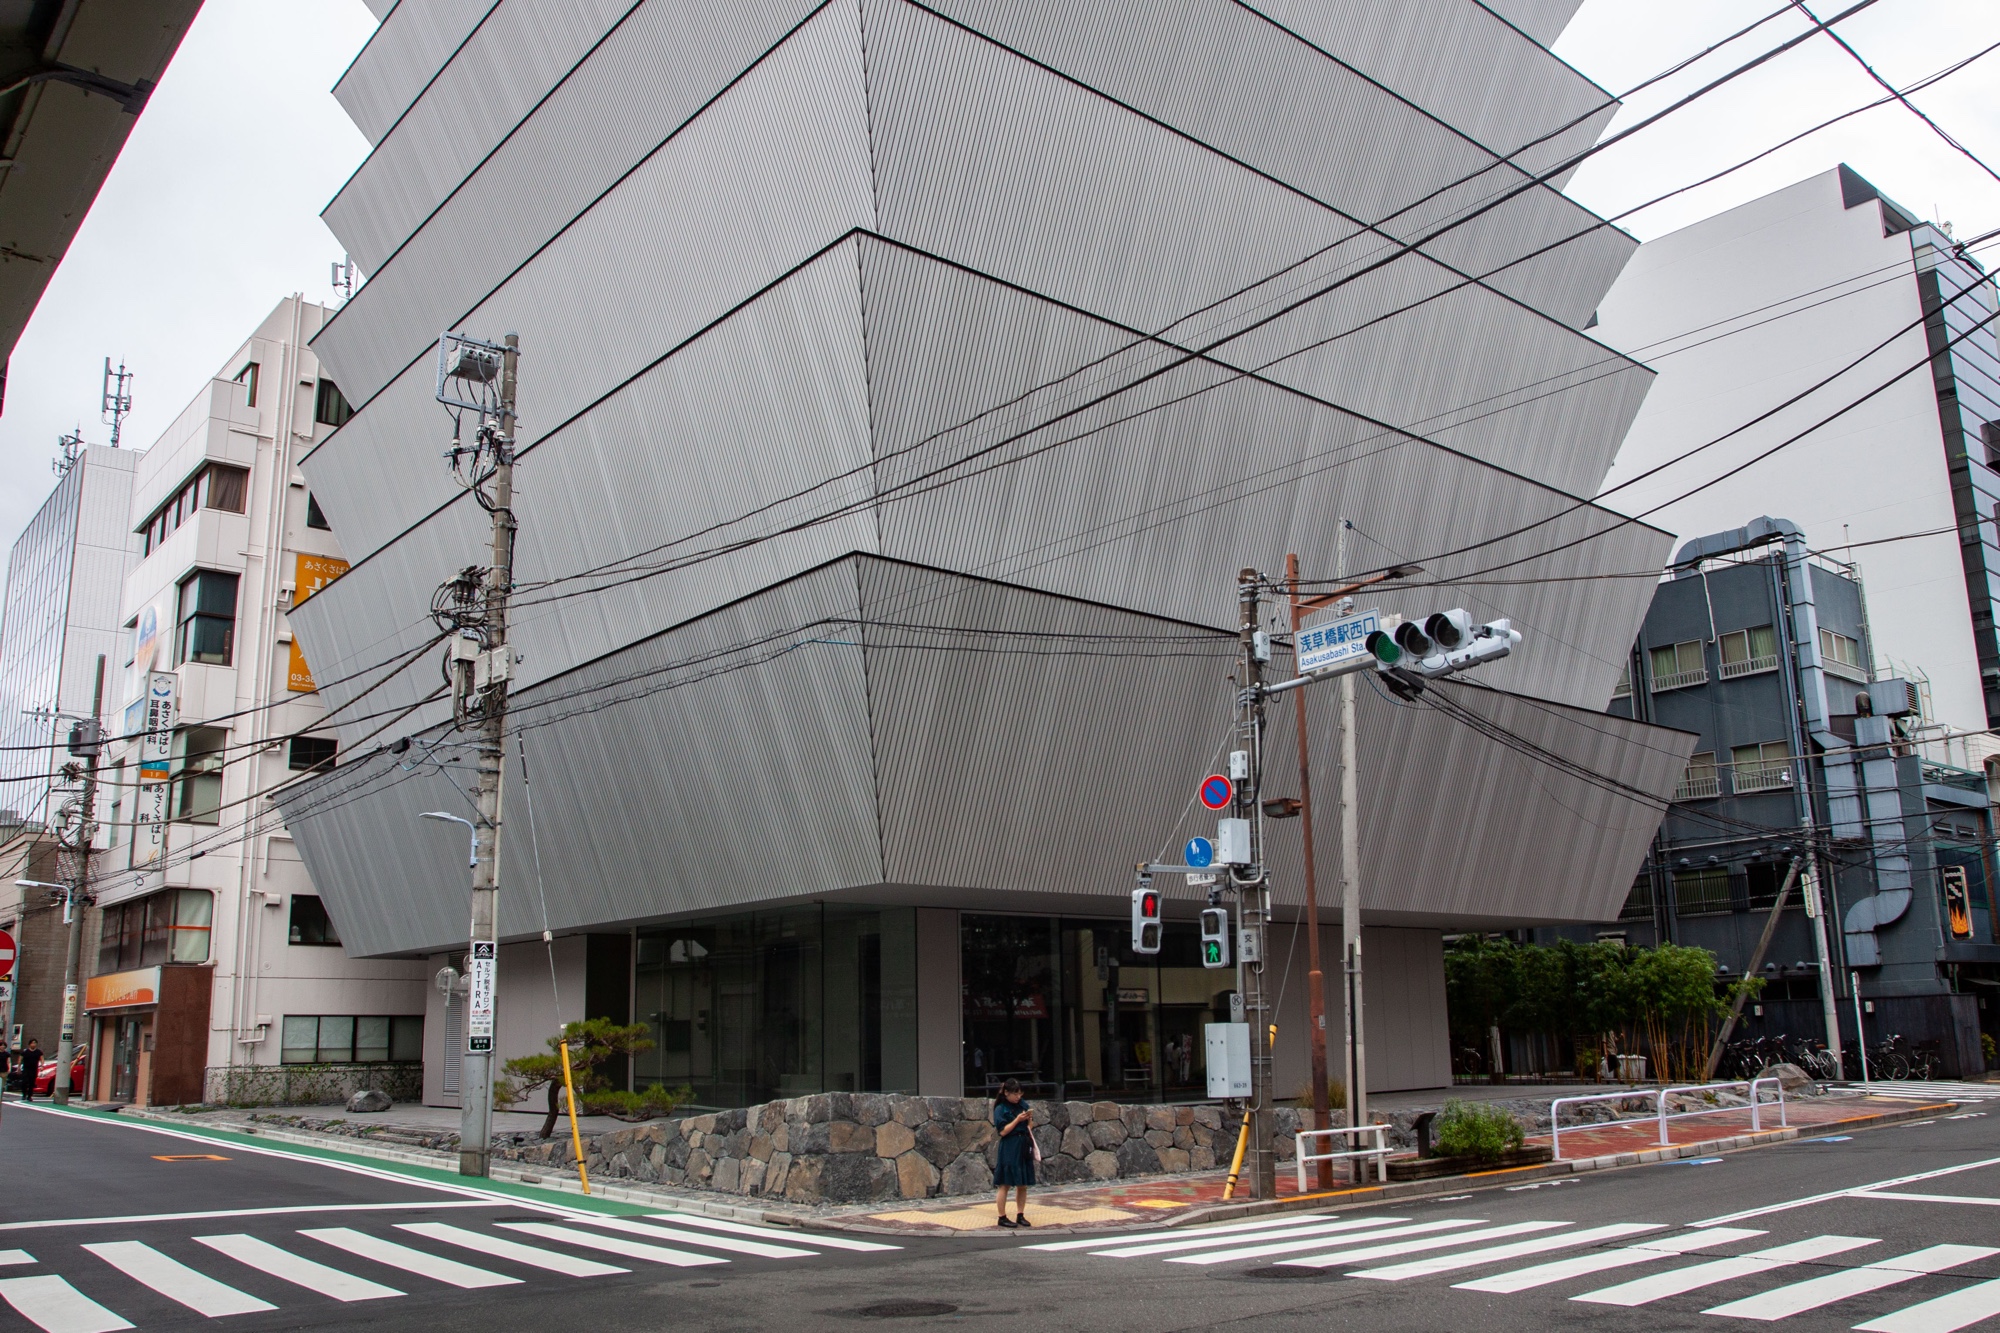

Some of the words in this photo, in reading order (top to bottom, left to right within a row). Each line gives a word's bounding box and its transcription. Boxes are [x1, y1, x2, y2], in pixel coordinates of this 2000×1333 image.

[1300, 616, 1375, 654] 浅草橋駅西口
[1301, 646, 1349, 667] Asakusabashi
[1351, 642, 1366, 653] Sta.
[159, 701, 172, 754] あさくさばし
[151, 784, 164, 844] あさくさばし
[1244, 934, 1253, 956] 交通
